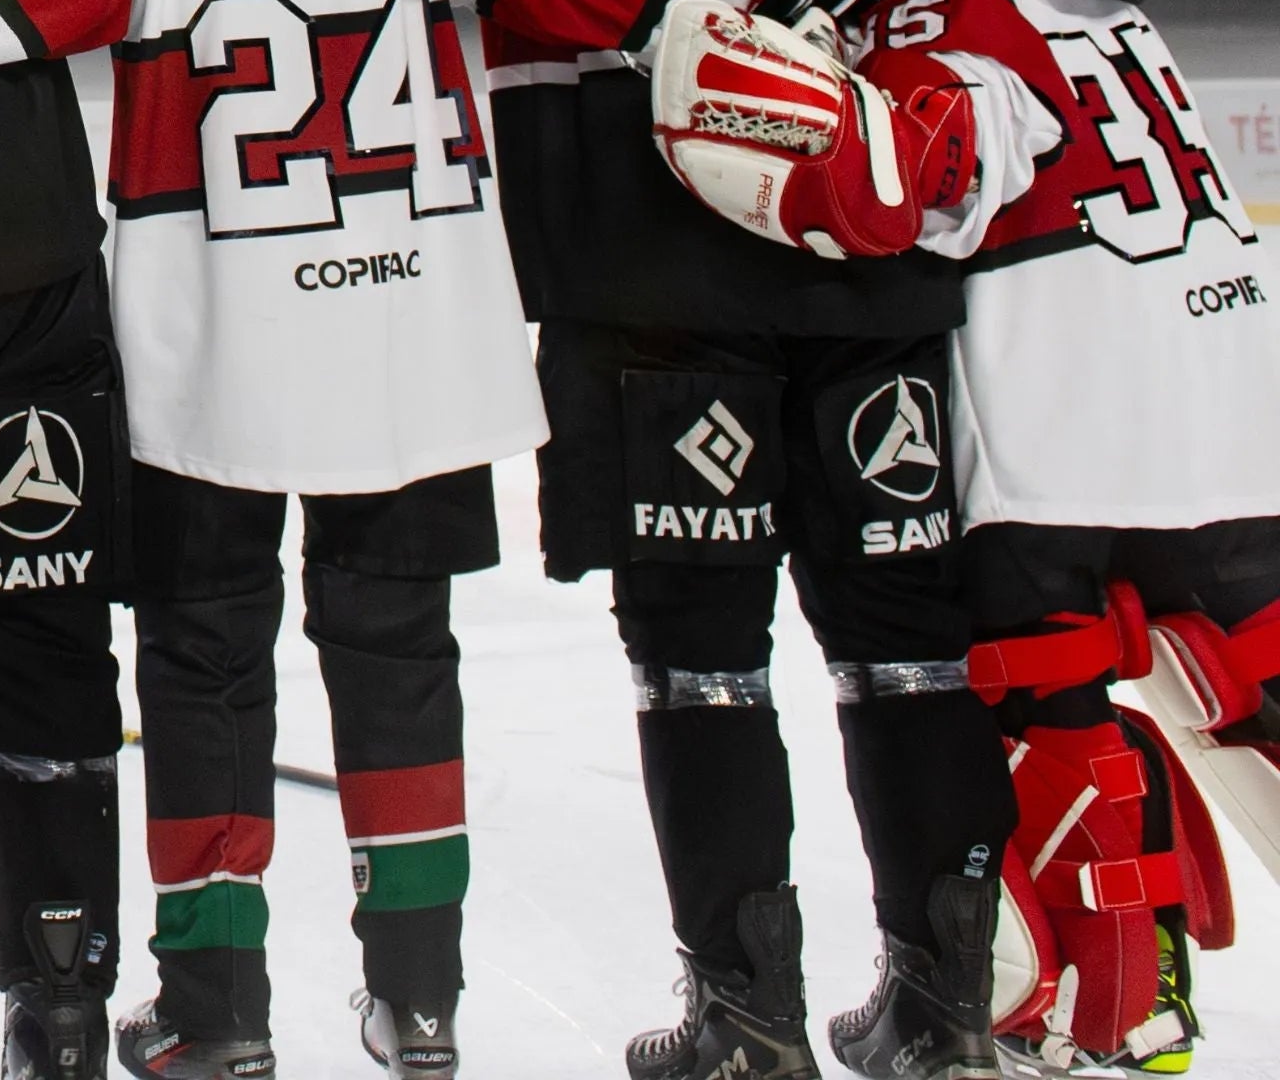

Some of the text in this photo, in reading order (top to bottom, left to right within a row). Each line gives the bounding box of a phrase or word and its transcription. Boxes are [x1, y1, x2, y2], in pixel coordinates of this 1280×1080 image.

[294, 250, 422, 292] COPIFAC
[634, 503, 758, 541] FAYAT
[41, 907, 83, 920] CCM
[233, 1057, 277, 1076] BAU
[401, 1050, 453, 1064] BAUER
